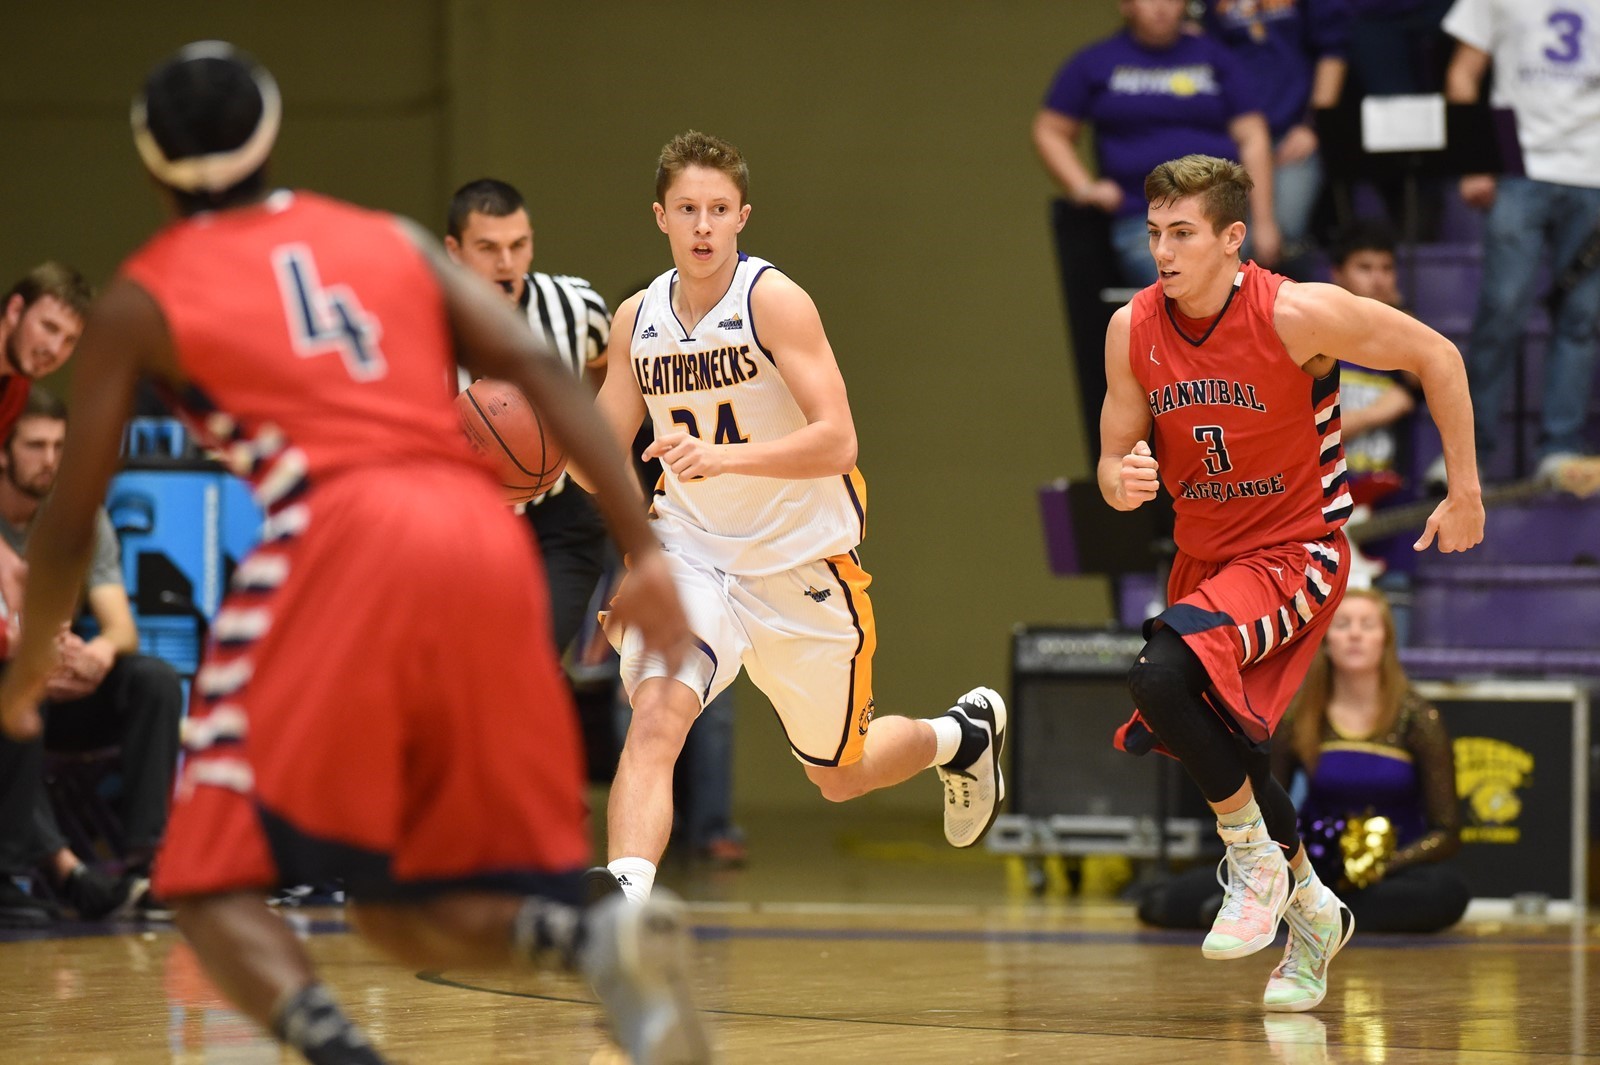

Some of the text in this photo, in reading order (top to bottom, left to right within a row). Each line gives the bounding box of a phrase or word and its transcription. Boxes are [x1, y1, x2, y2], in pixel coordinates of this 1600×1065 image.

[1544, 11, 1583, 63] 3
[270, 241, 389, 384] 4
[634, 345, 758, 396] LEATHERNECKS
[1148, 379, 1267, 417] HANNIBAL
[1193, 425, 1233, 476] 3
[1178, 473, 1286, 503] AGRANGE
